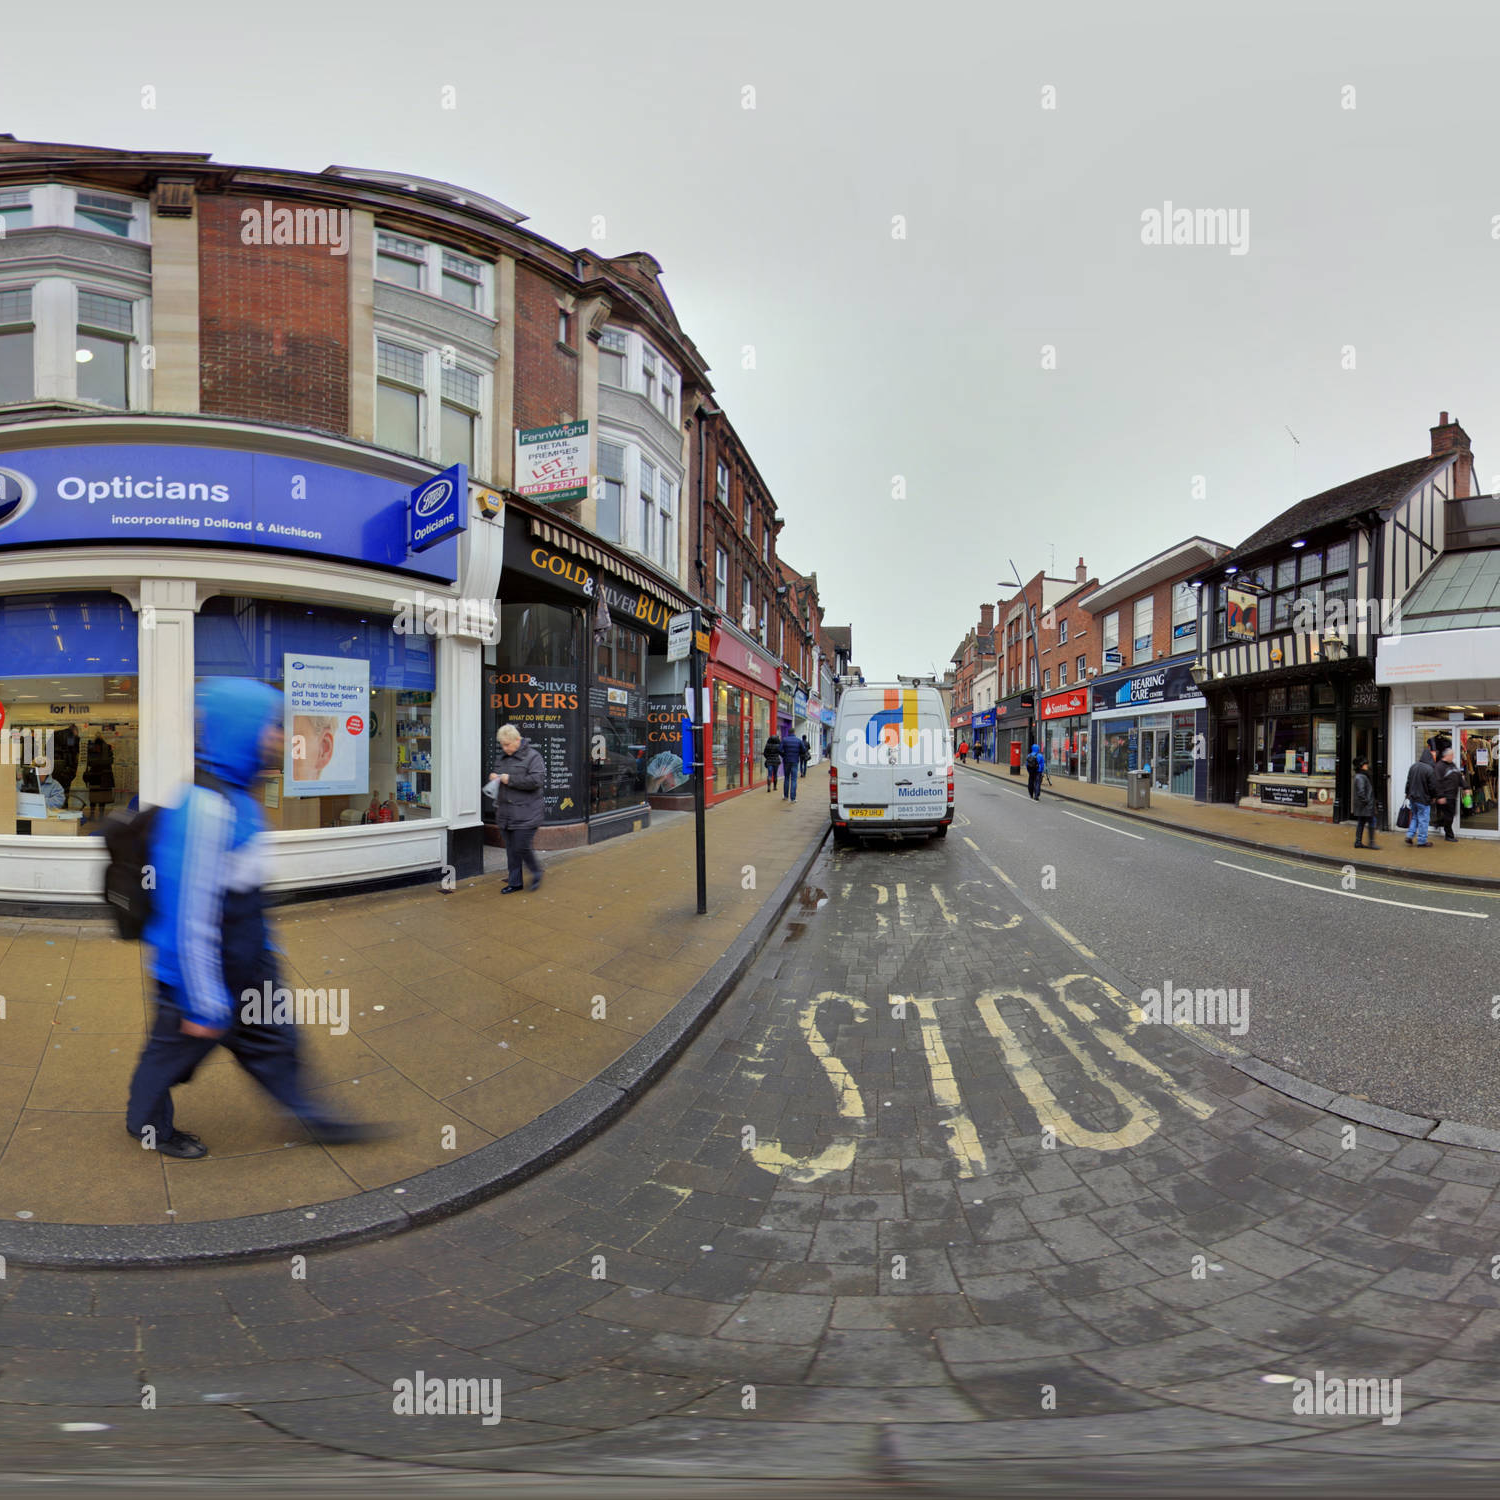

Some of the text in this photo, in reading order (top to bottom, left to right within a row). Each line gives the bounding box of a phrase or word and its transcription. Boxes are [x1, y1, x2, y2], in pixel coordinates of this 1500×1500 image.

[521, 424, 585, 443] FennWright
[528, 446, 579, 460] PREMISES
[536, 440, 570, 451] RETAIL
[532, 457, 562, 479] LET
[57, 475, 230, 503] Opticians
[420, 484, 446, 513] Boots
[111, 514, 323, 540] incorporating Dollond & Aitchison
[414, 513, 455, 541] Opticians
[531, 548, 589, 585] GOLD
[582, 577, 594, 596] &
[308, 682, 336, 690] invisible
[338, 684, 364, 693] hearing
[489, 673, 578, 693] GOLD & SILVER
[1131, 674, 1165, 690] HEARING
[490, 693, 579, 710] BUYERS
[1131, 688, 1149, 701] CARE
[50, 704, 90, 714] for him
[313, 700, 342, 708] believed
[898, 787, 943, 797] Middleton
[744, 974, 1217, 1183] STOP
